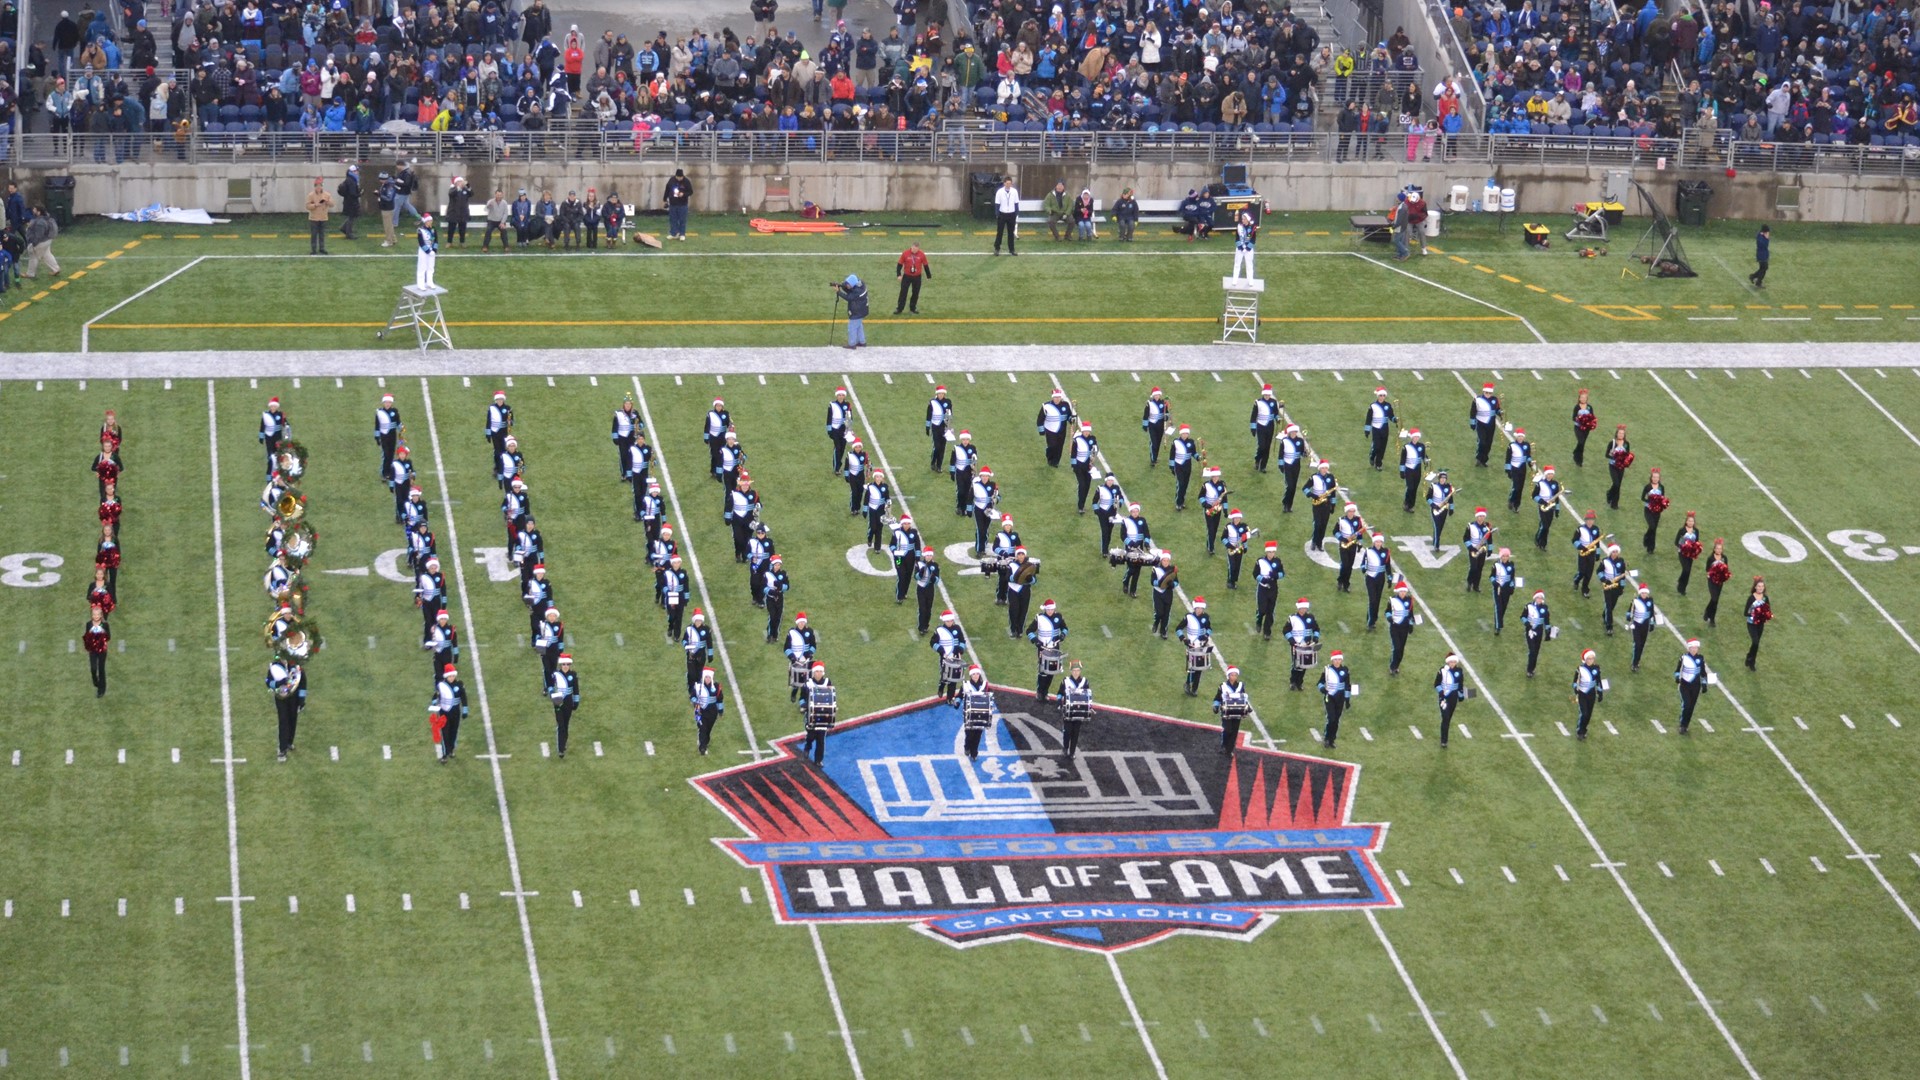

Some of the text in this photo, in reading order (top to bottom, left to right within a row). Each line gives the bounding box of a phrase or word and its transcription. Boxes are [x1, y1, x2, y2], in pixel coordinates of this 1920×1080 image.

[766, 831, 1355, 859] PRO FOOTBALL
[797, 855, 1360, 907] HALL OF FAME
[1136, 907, 1234, 923] OHIO
